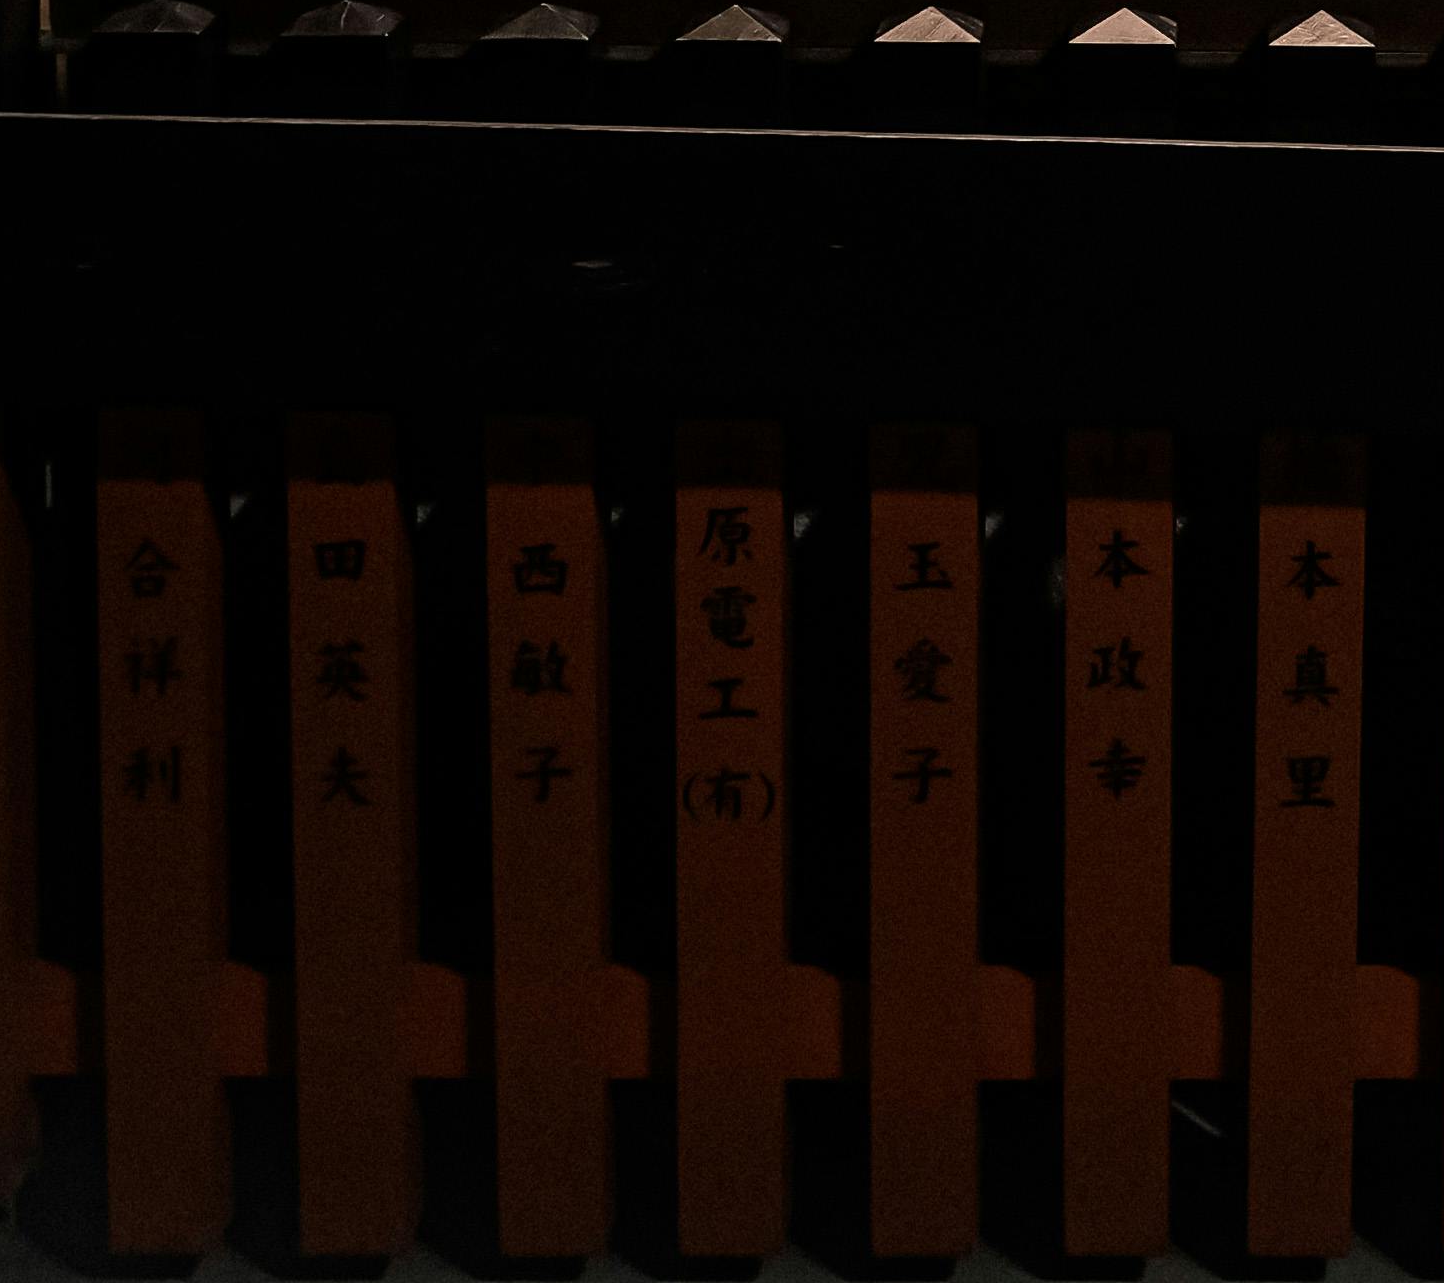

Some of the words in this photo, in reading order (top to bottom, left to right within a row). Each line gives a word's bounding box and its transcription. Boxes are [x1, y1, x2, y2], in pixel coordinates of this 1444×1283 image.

[122, 538, 181, 806] 合祥利
[311, 538, 370, 809] 田英夫
[509, 542, 572, 805] 西敏子
[683, 506, 776, 823] 原電工(有)
[894, 538, 954, 805] 玉愛子
[1087, 529, 1149, 799] 本政幸
[1281, 539, 1342, 811] 本真里
